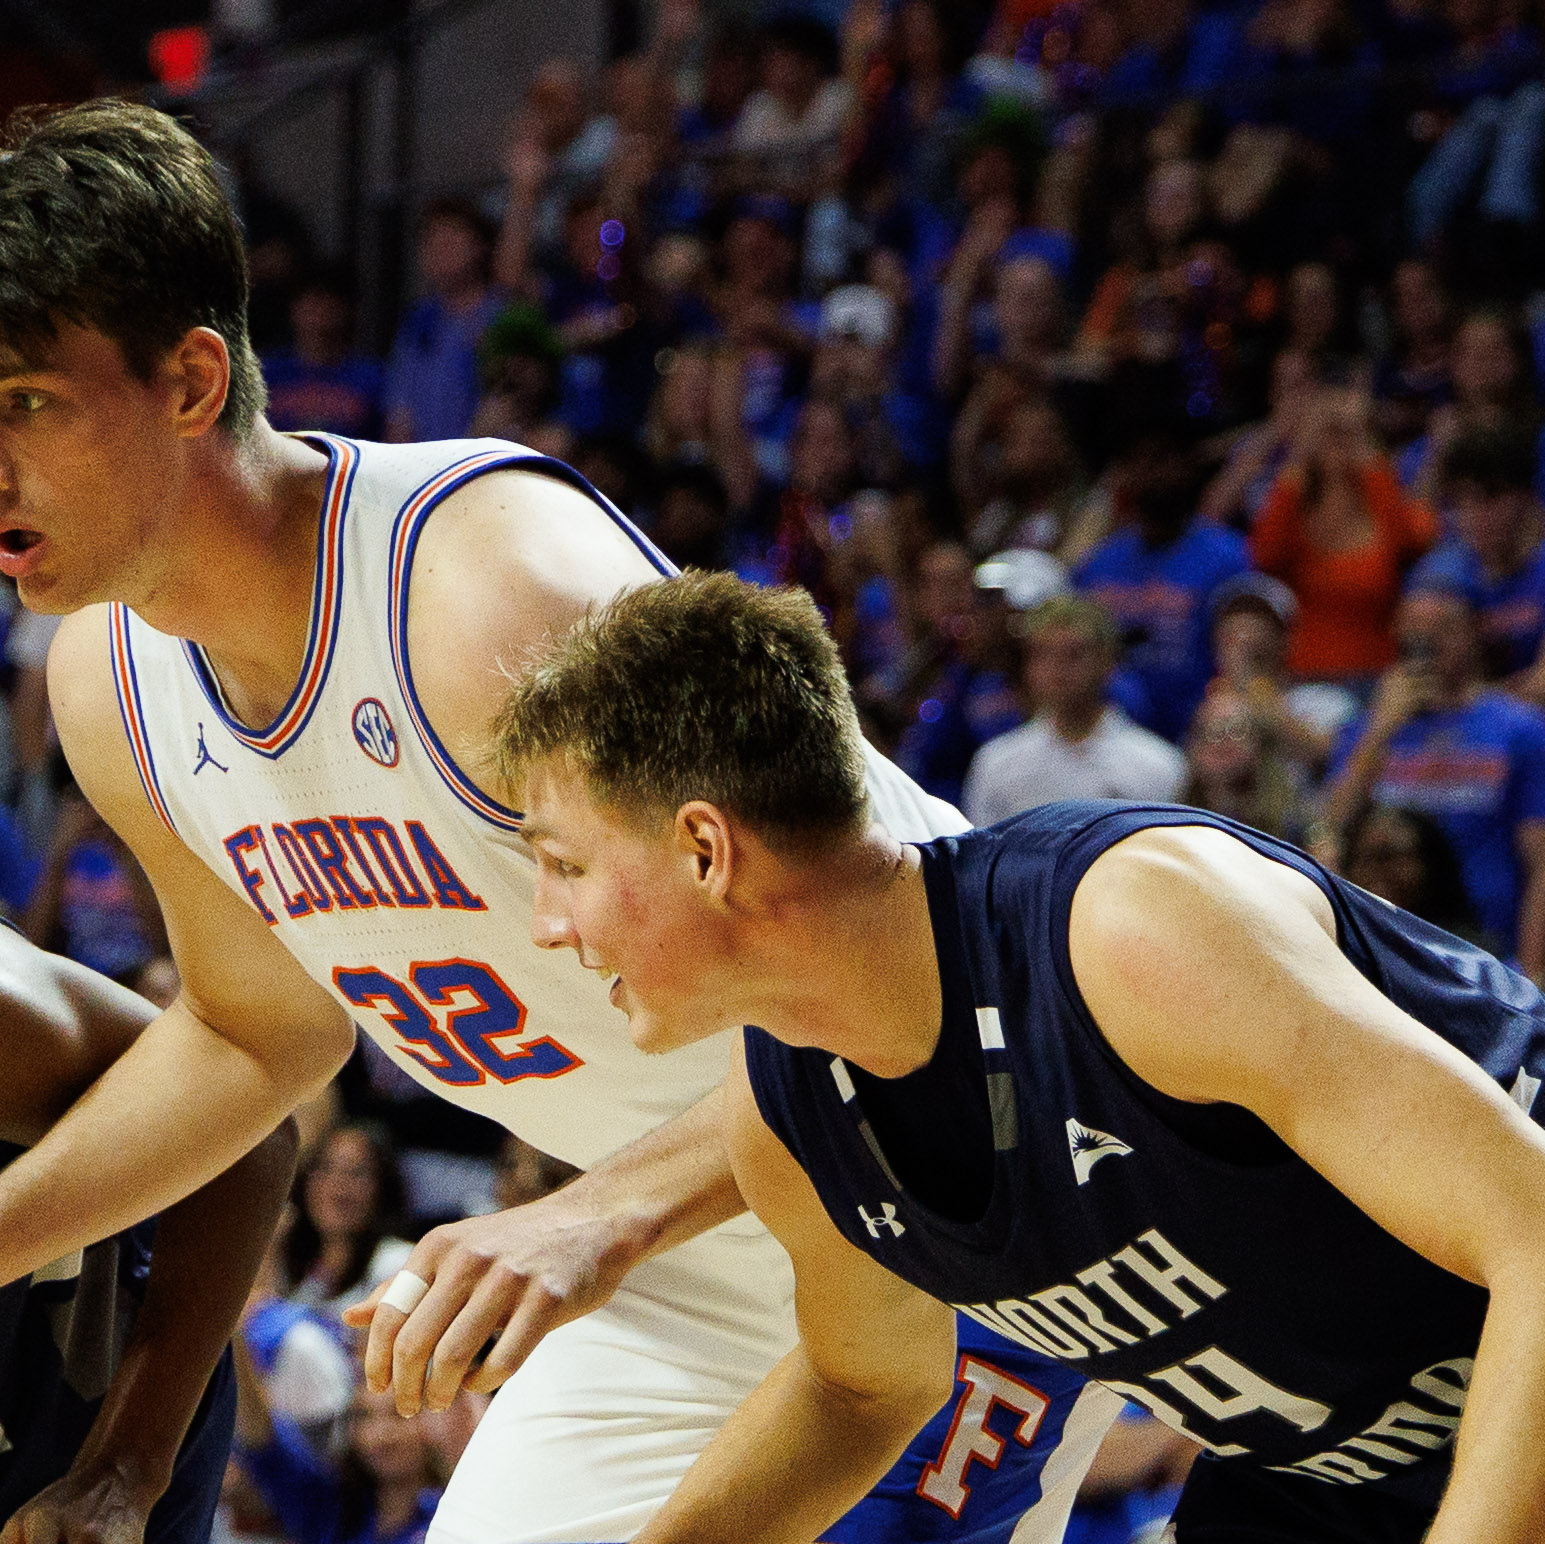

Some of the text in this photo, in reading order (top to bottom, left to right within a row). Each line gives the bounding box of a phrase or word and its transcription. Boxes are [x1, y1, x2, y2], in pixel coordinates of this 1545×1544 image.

[223, 815, 489, 927] FLORIDA
[332, 957, 586, 1087] 32
[948, 1227, 1230, 1360] NORTH
[916, 1353, 1051, 1520] F
